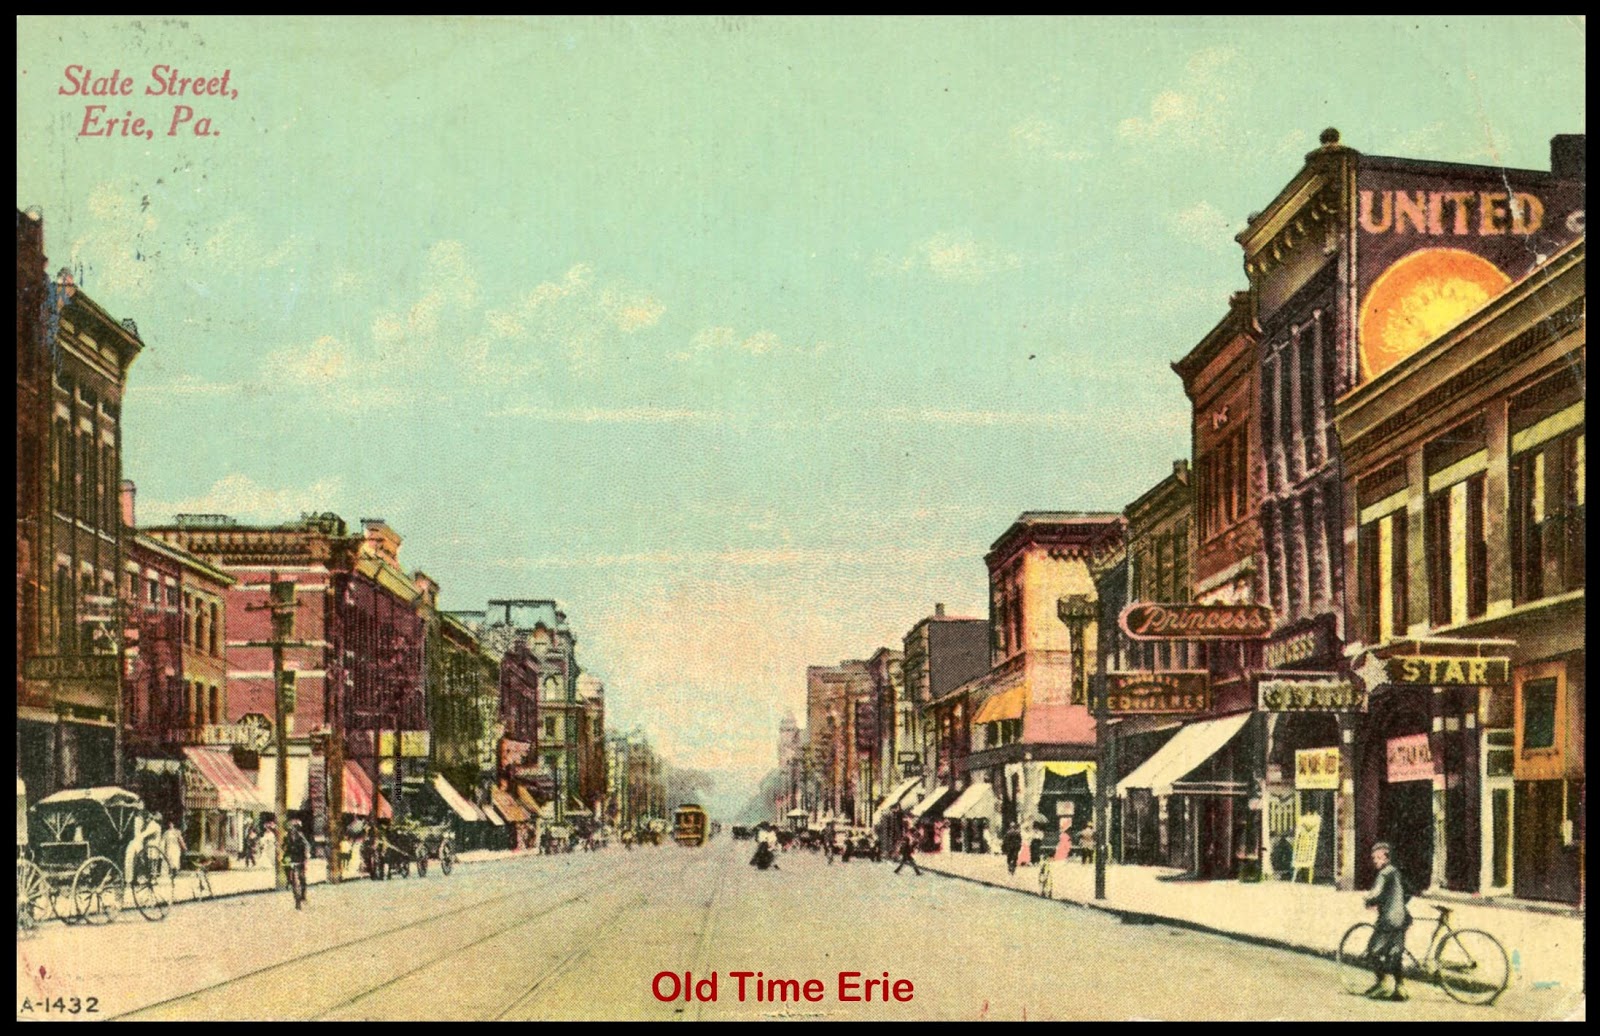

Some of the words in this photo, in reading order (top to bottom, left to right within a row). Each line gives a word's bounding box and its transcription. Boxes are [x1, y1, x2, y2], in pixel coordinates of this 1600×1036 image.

[1358, 190, 1544, 235] UNITED
[1135, 605, 1267, 634] Princess
[1402, 658, 1489, 684] STAR
